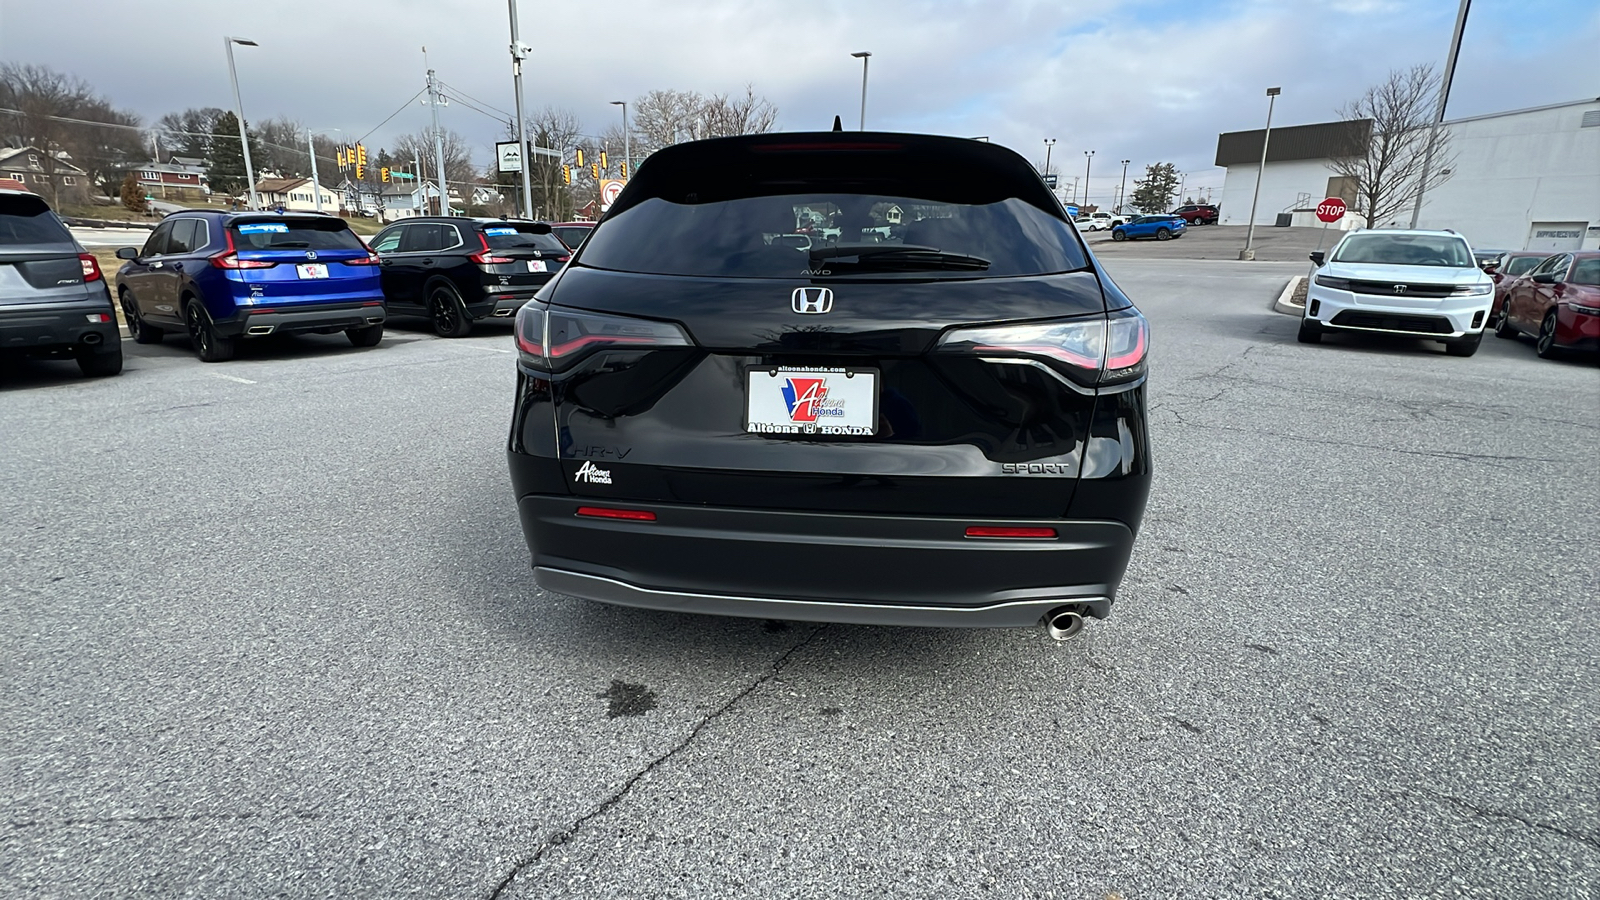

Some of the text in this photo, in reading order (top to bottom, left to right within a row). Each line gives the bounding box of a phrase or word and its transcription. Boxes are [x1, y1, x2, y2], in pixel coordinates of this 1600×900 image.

[1317, 204, 1345, 216] STOP
[791, 381, 844, 417] Altoona
[812, 407, 843, 417] Honda
[747, 422, 799, 433] Altoona
[821, 426, 874, 436] HONDA
[573, 445, 632, 460] HR-V
[1002, 463, 1069, 474] SPORT
[589, 476, 613, 485] Honda
